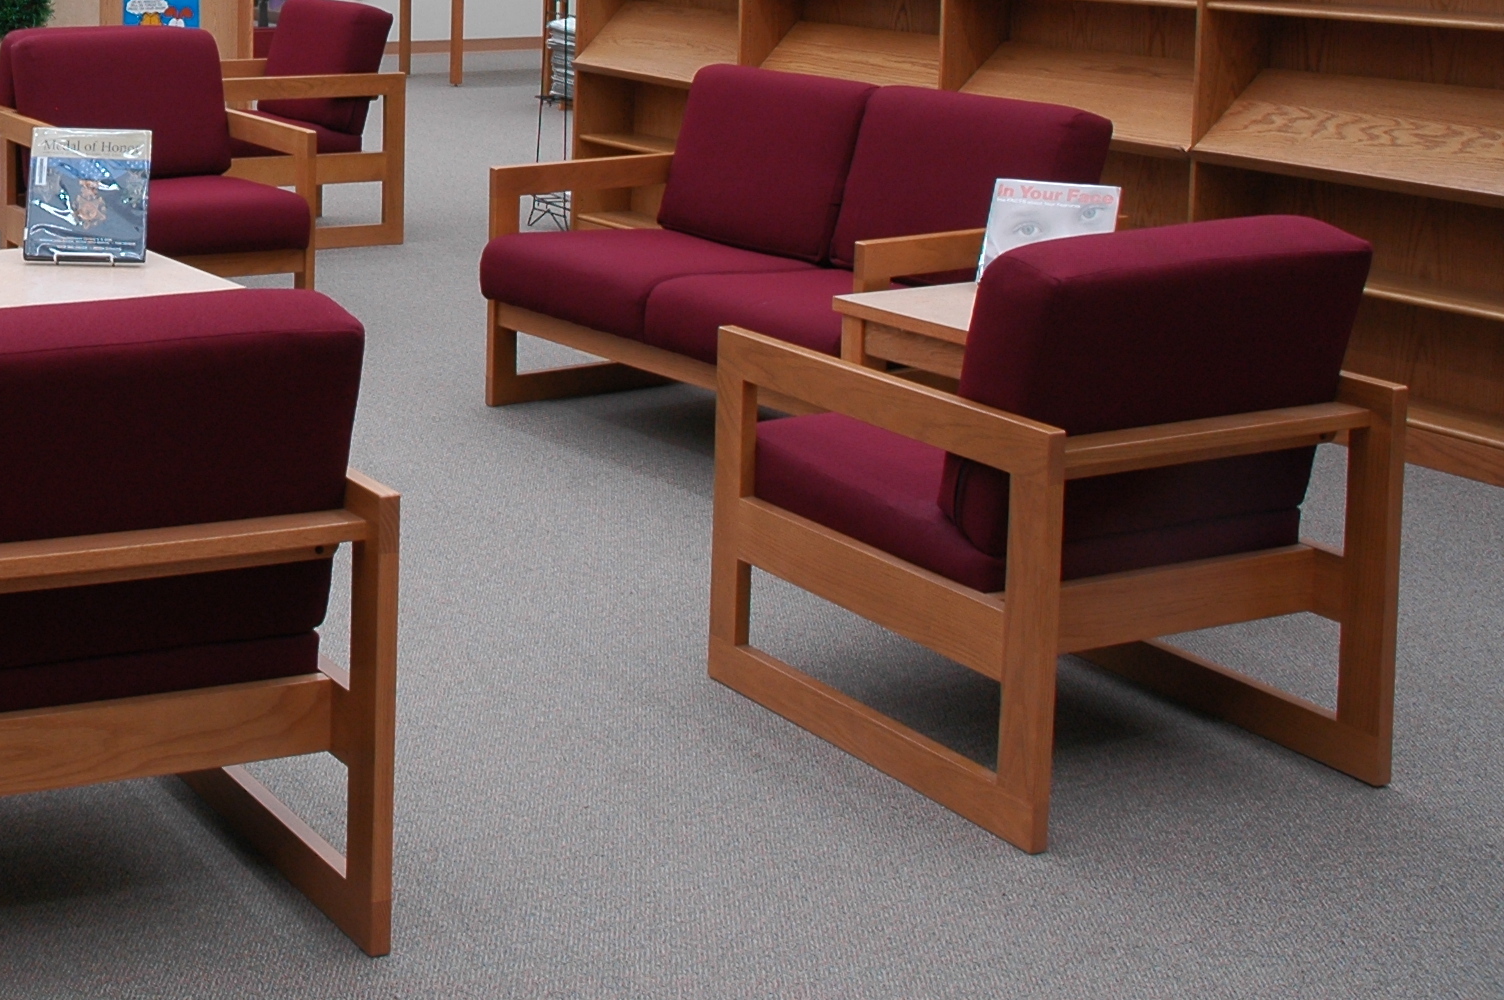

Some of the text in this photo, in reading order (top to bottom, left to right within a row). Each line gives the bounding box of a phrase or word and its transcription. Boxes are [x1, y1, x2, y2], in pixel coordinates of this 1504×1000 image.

[43, 139, 80, 151] Medal
[84, 140, 96, 151] of
[998, 184, 1114, 205] In Your Face
